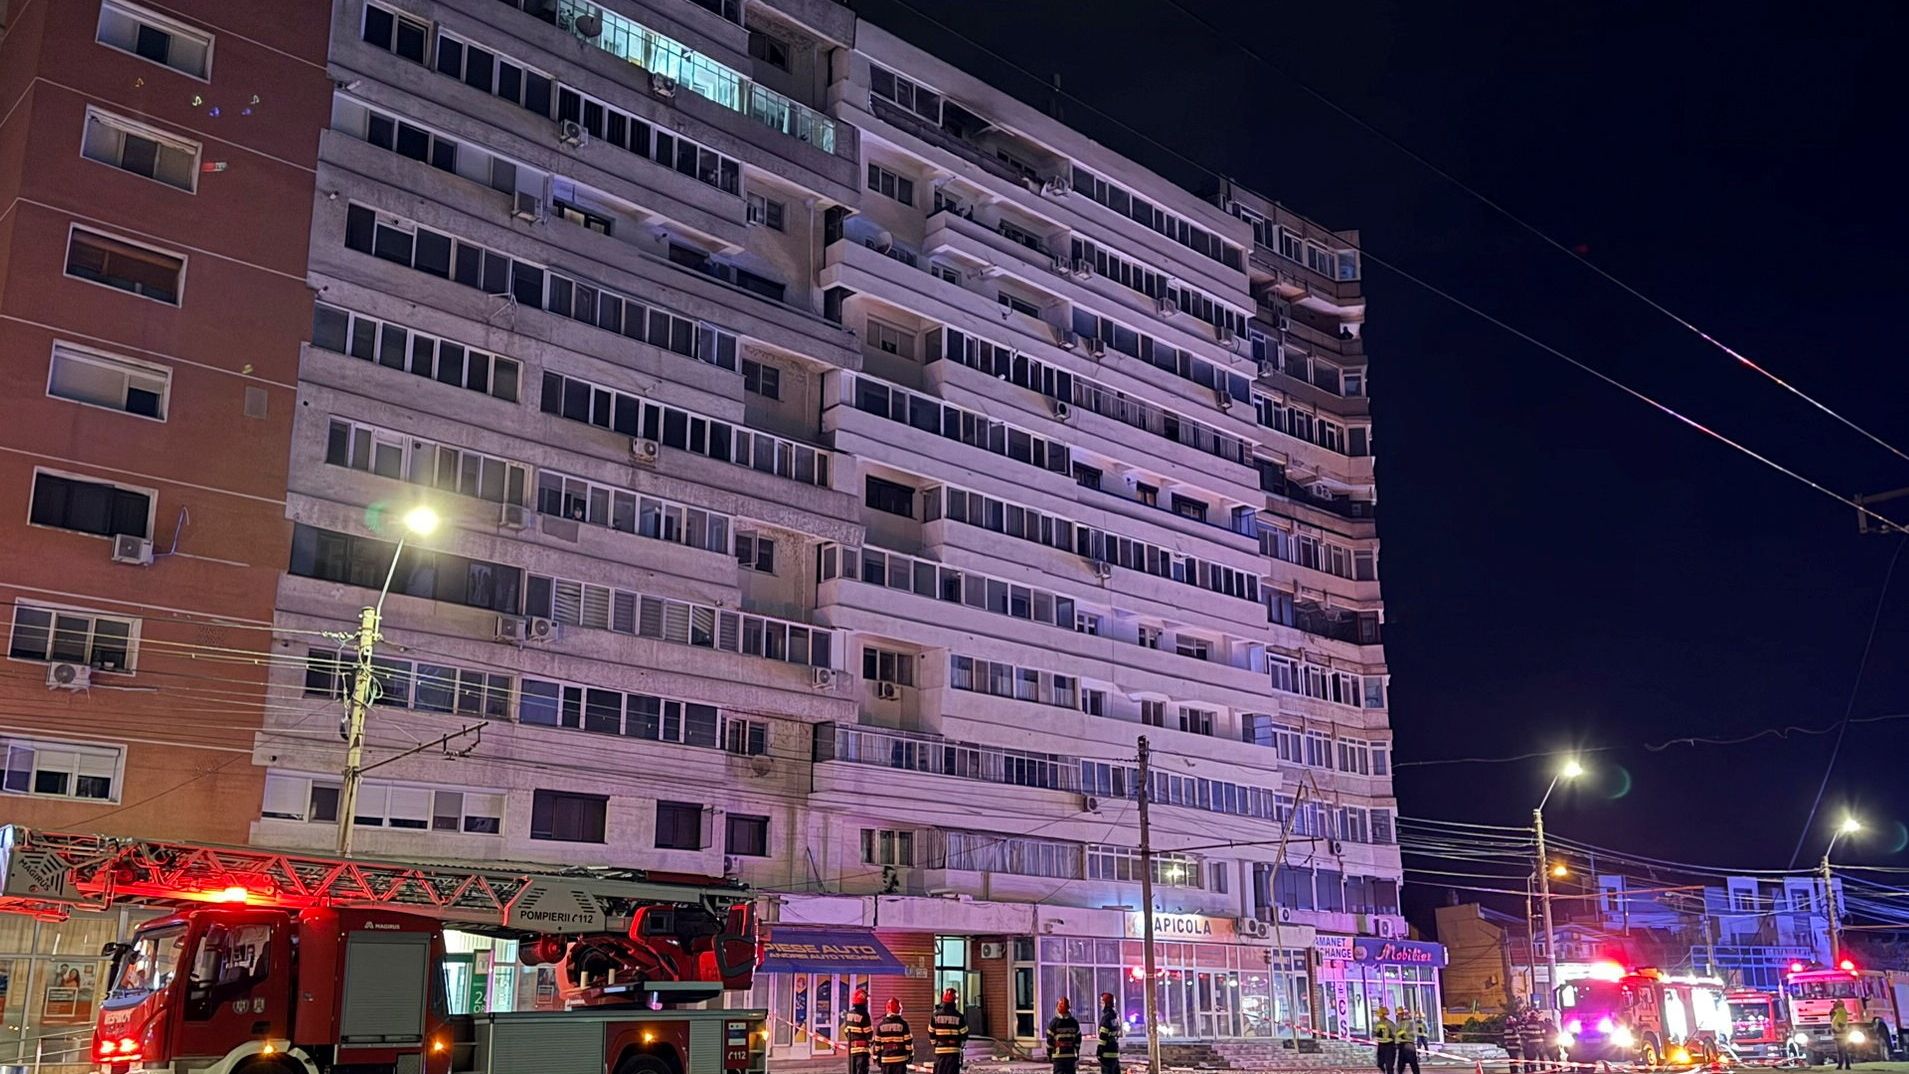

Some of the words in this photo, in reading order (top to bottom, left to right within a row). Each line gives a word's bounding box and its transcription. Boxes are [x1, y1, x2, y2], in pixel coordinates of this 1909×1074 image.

[18, 859, 51, 891] MAGIRUS
[520, 910, 570, 922] POMPIERII
[578, 914, 593, 924] 112
[1154, 916, 1212, 935] APICOLA
[764, 943, 820, 954] PIESE
[822, 944, 877, 955] AUTO
[1375, 943, 1432, 962] Mobilier
[734, 1051, 746, 1060] 112
